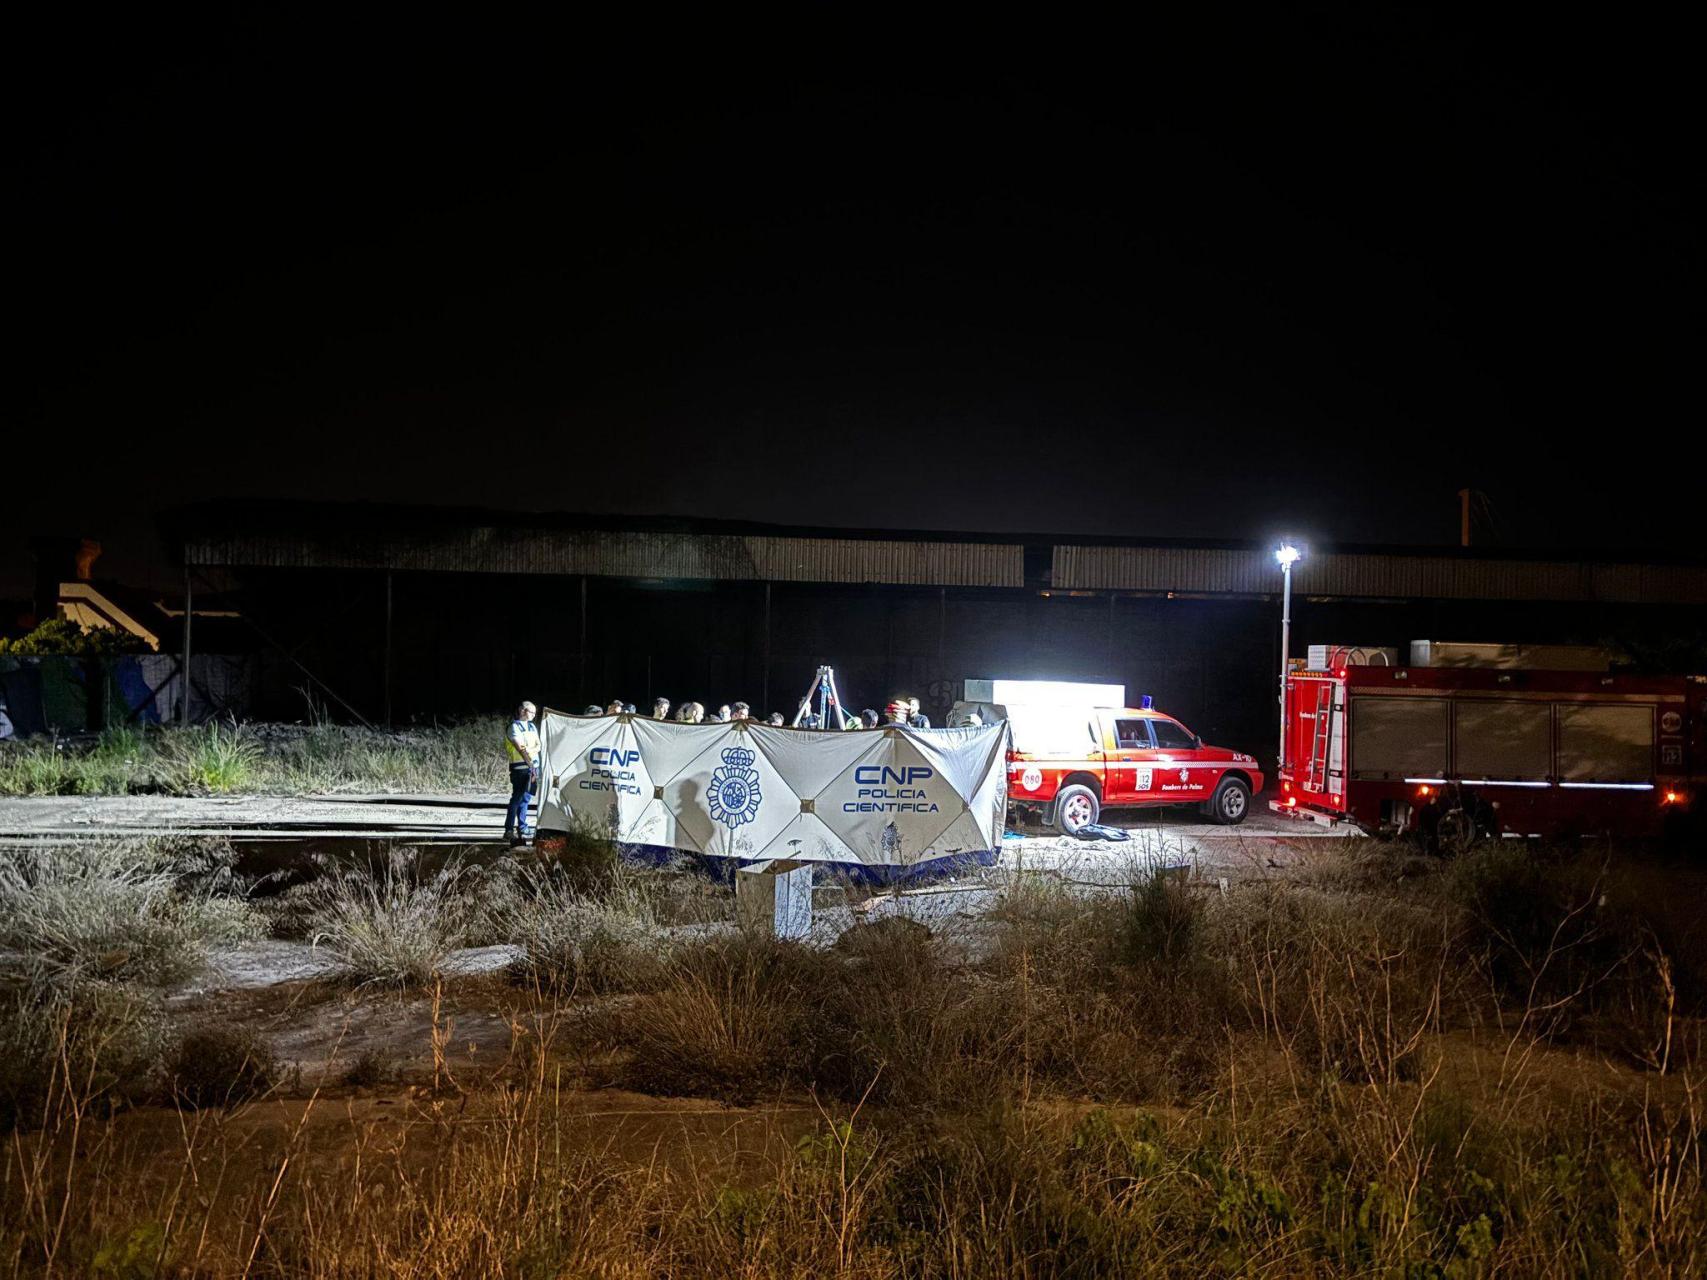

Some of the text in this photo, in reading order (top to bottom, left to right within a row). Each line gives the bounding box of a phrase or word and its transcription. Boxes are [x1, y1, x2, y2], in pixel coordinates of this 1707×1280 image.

[589, 747, 640, 767] CNP
[591, 769, 636, 782] POLICIA
[854, 766, 933, 785] CNP
[579, 781, 642, 796] CIENTIFICA
[858, 789, 926, 799] POLICIA
[843, 802, 940, 813] CIENTIFICA
